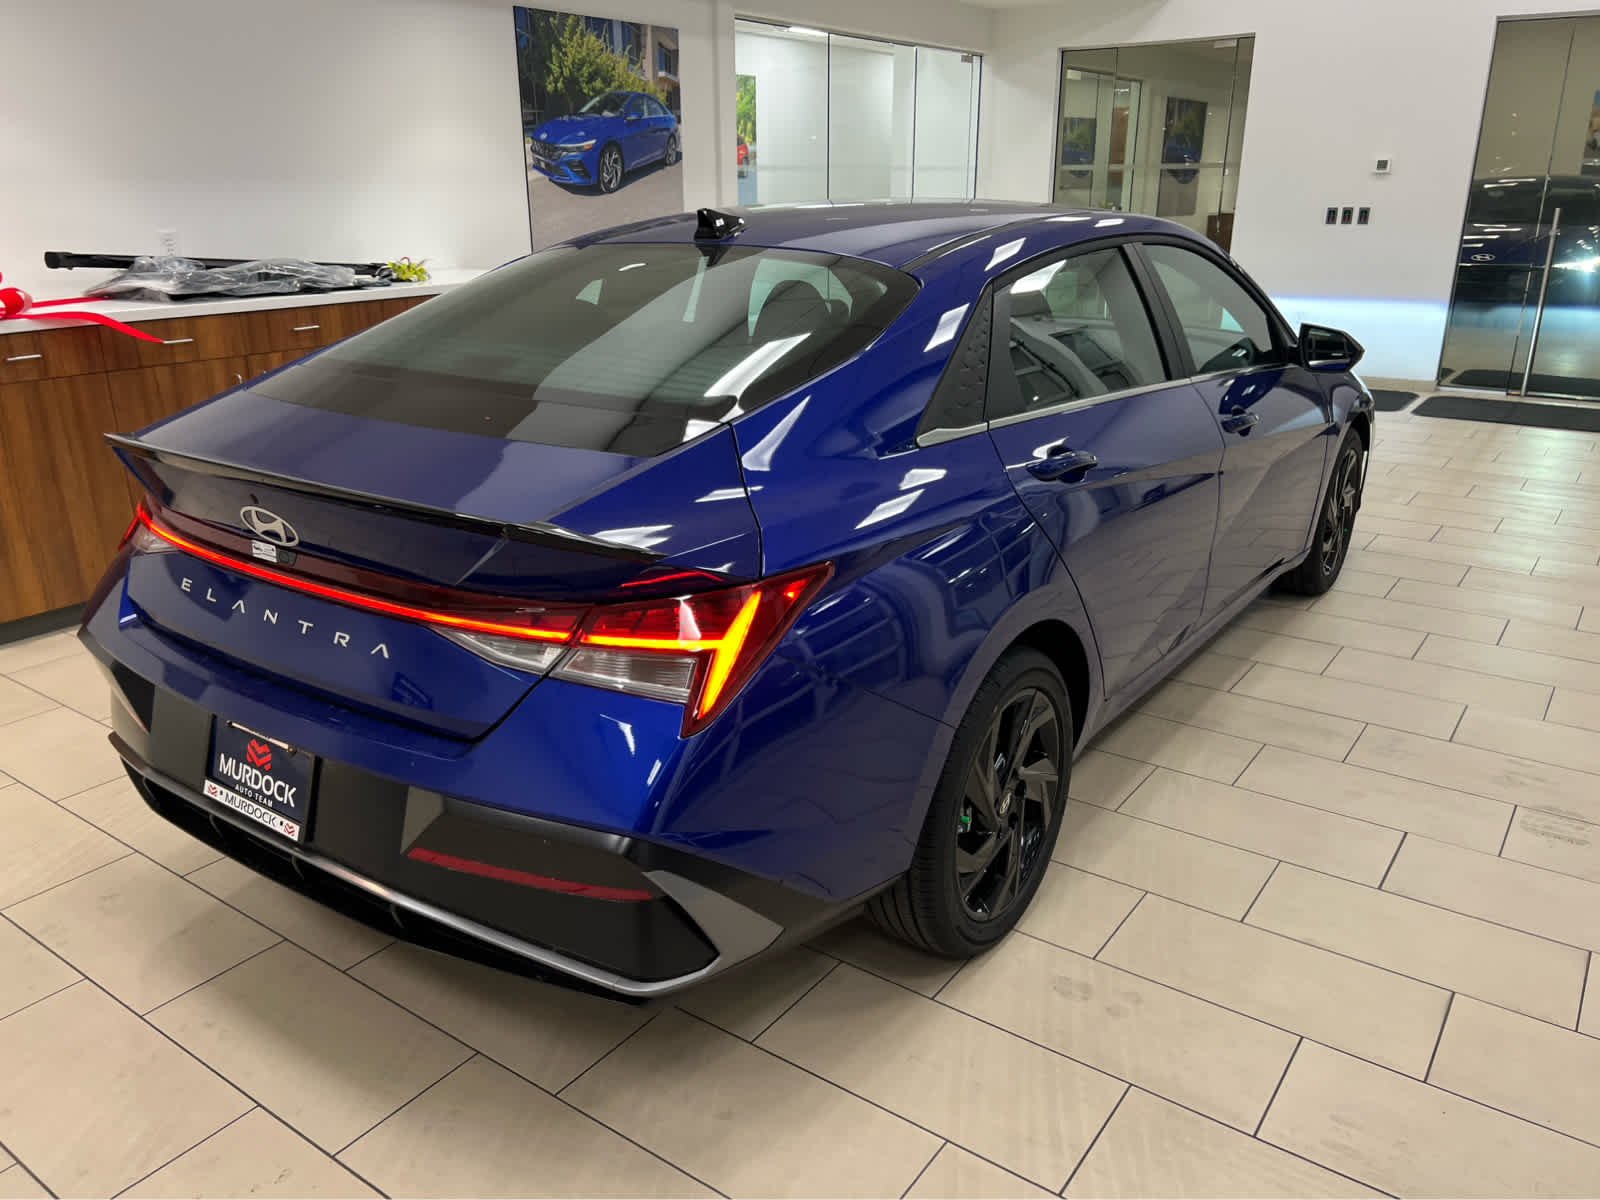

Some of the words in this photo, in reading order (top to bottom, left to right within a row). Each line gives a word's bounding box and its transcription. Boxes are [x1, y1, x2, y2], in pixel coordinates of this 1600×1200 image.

[181, 577, 390, 659] ELANTRA
[219, 753, 297, 808] MURDOCK
[235, 784, 252, 798] AUTO
[255, 795, 273, 808] TEAM
[224, 793, 277, 827] MURDOCK
